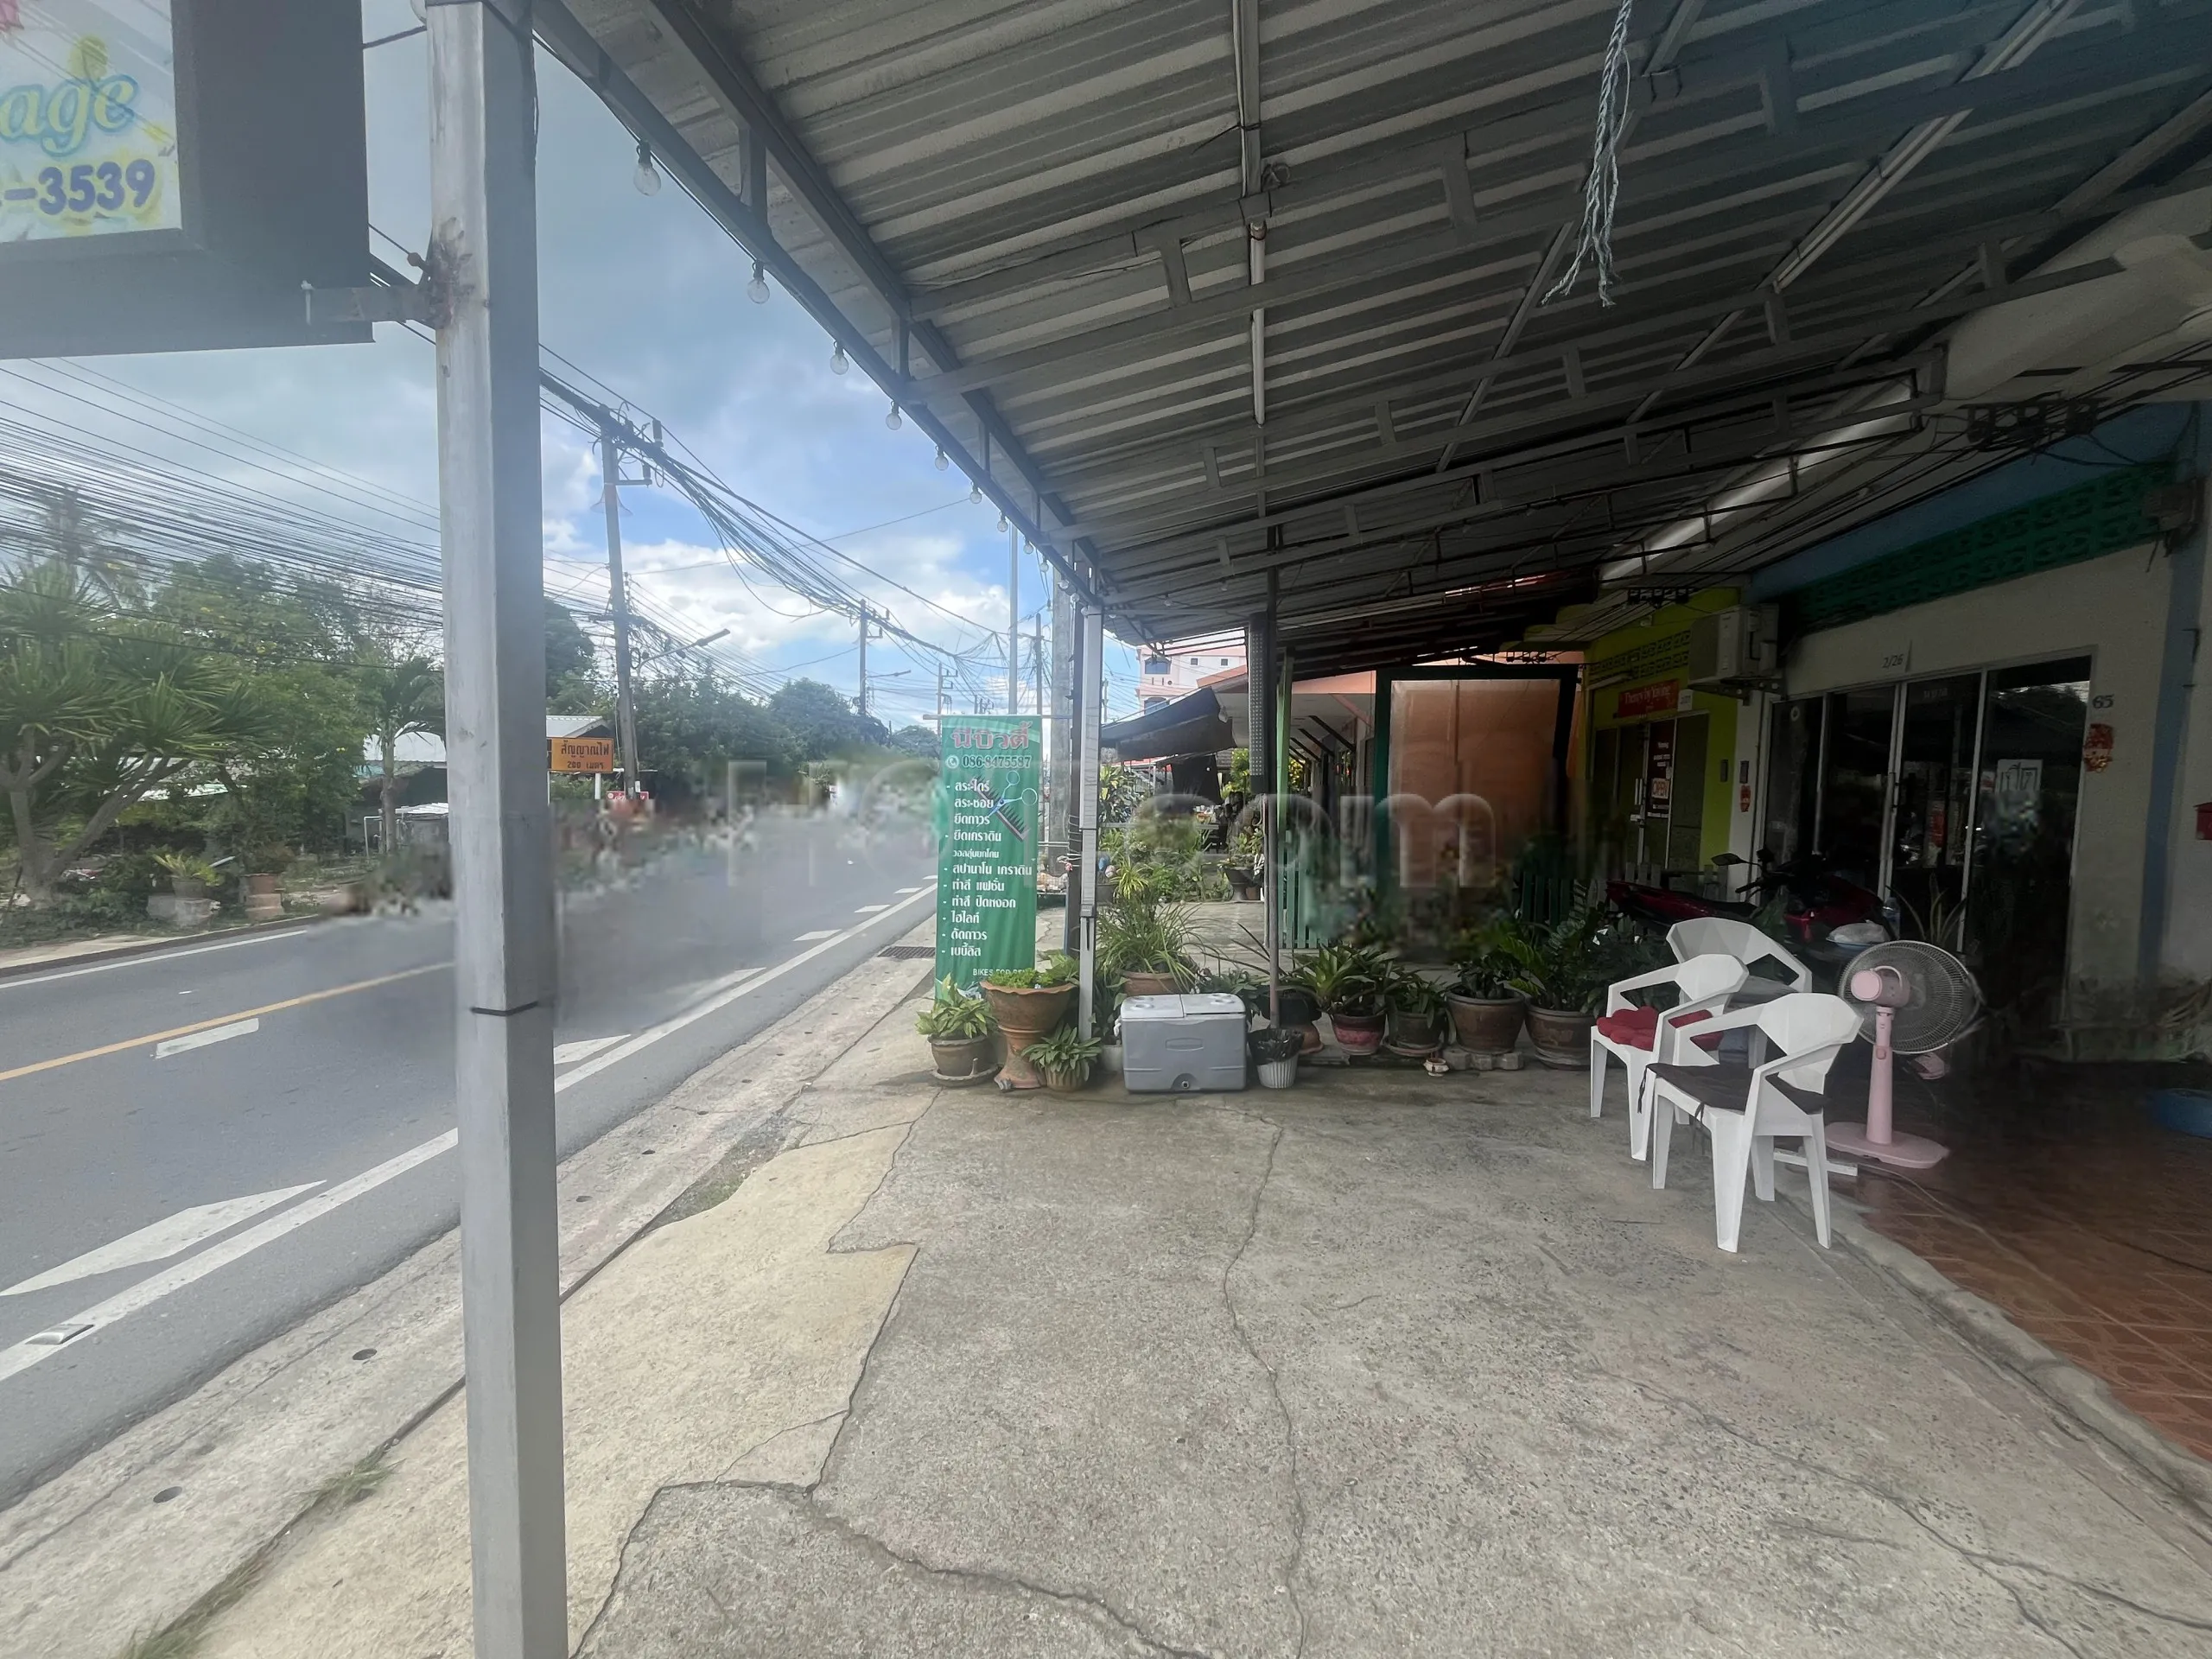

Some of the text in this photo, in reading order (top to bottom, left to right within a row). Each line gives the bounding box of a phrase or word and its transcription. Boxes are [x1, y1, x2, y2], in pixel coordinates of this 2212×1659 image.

[0, 159, 156, 215] -3539
[2092, 694, 2114, 709] 65
[561, 740, 610, 758] สัญญาณไฟ
[567, 760, 604, 770] 200 เมตร
[962, 754, 1033, 769] 086-8475587
[953, 829, 1002, 842] ยืดเคราติน
[952, 861, 1033, 875] สปานาโน เคราติน
[952, 877, 1005, 892] ทำสี แฟชั่น
[951, 894, 1016, 908] ทำสี ปิดหงอก
[950, 910, 980, 924] ไฮไลท์
[950, 927, 988, 941] ดัดถาวร
[972, 968, 994, 976] BIKES
